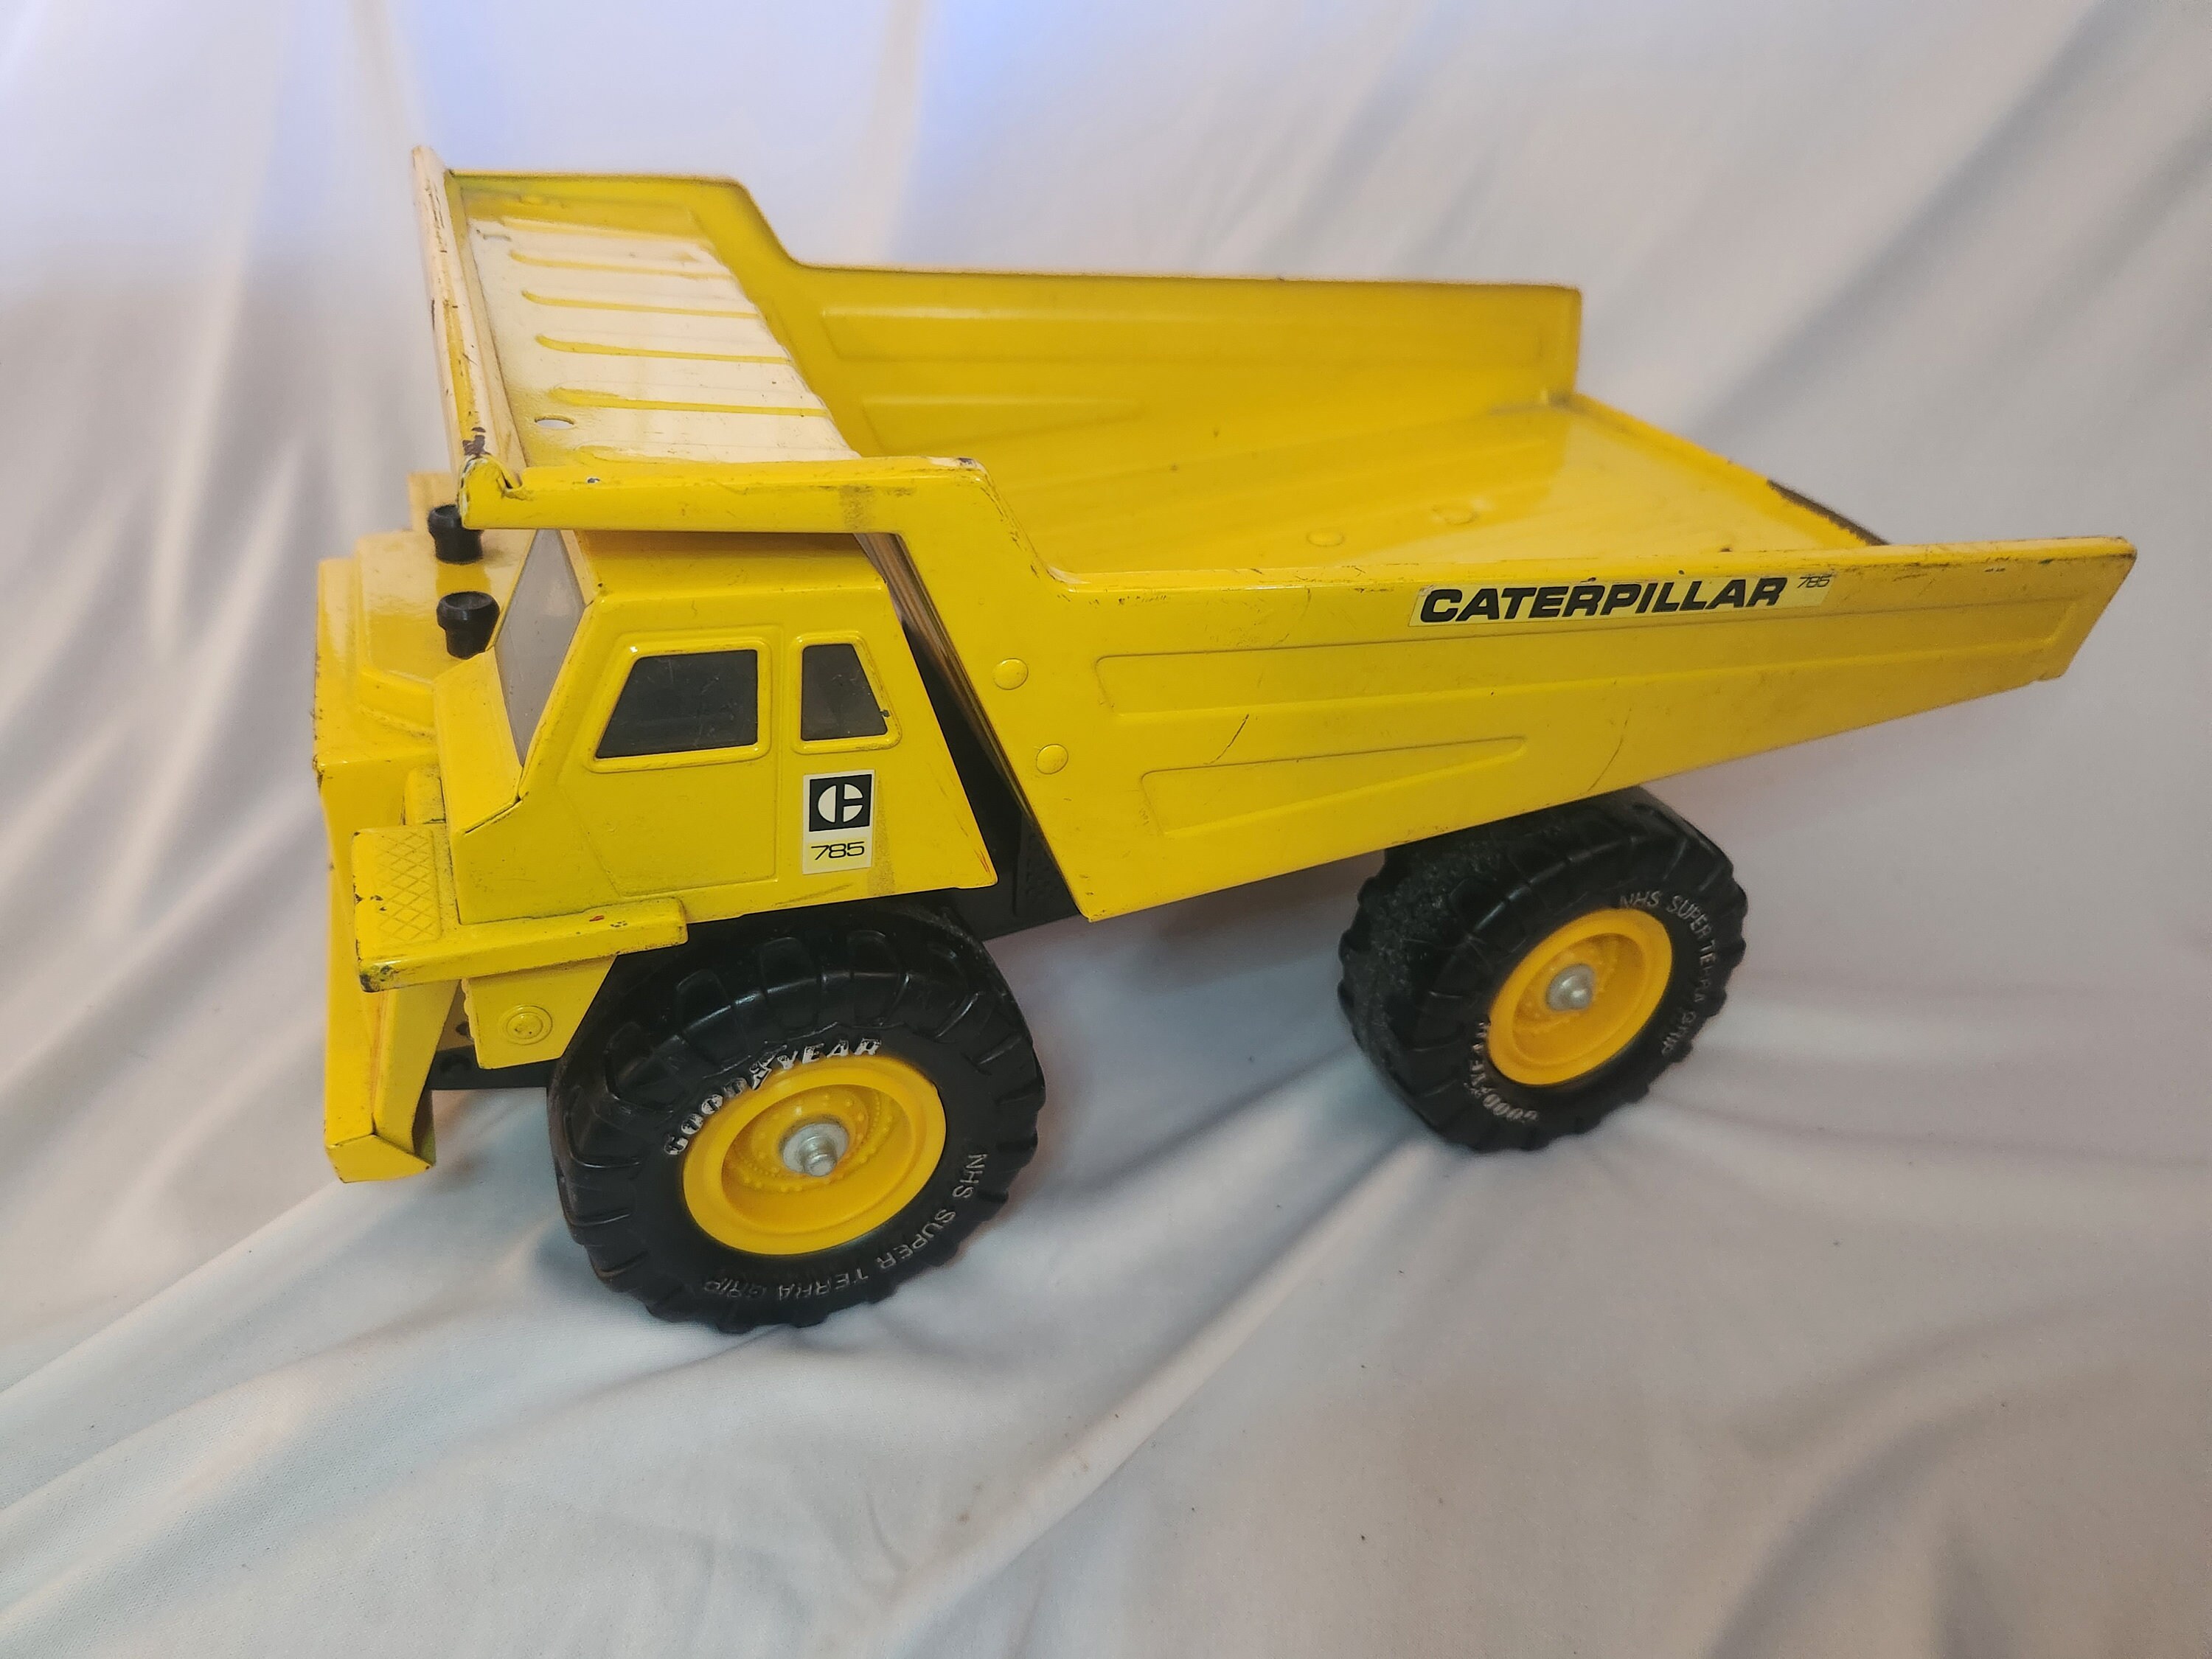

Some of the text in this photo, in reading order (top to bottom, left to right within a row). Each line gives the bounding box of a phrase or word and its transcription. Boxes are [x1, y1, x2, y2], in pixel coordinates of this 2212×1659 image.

[1420, 574, 1832, 623] CATERPILLAR 785
[811, 841, 865, 860] 785
[1621, 891, 1660, 908] NHS
[1666, 895, 1712, 939] SUPER
[664, 1038, 882, 1155] GOODYEAR
[953, 1152, 988, 1199] NHS
[876, 1208, 956, 1270] SUPER
[778, 1267, 869, 1301] TERRA
